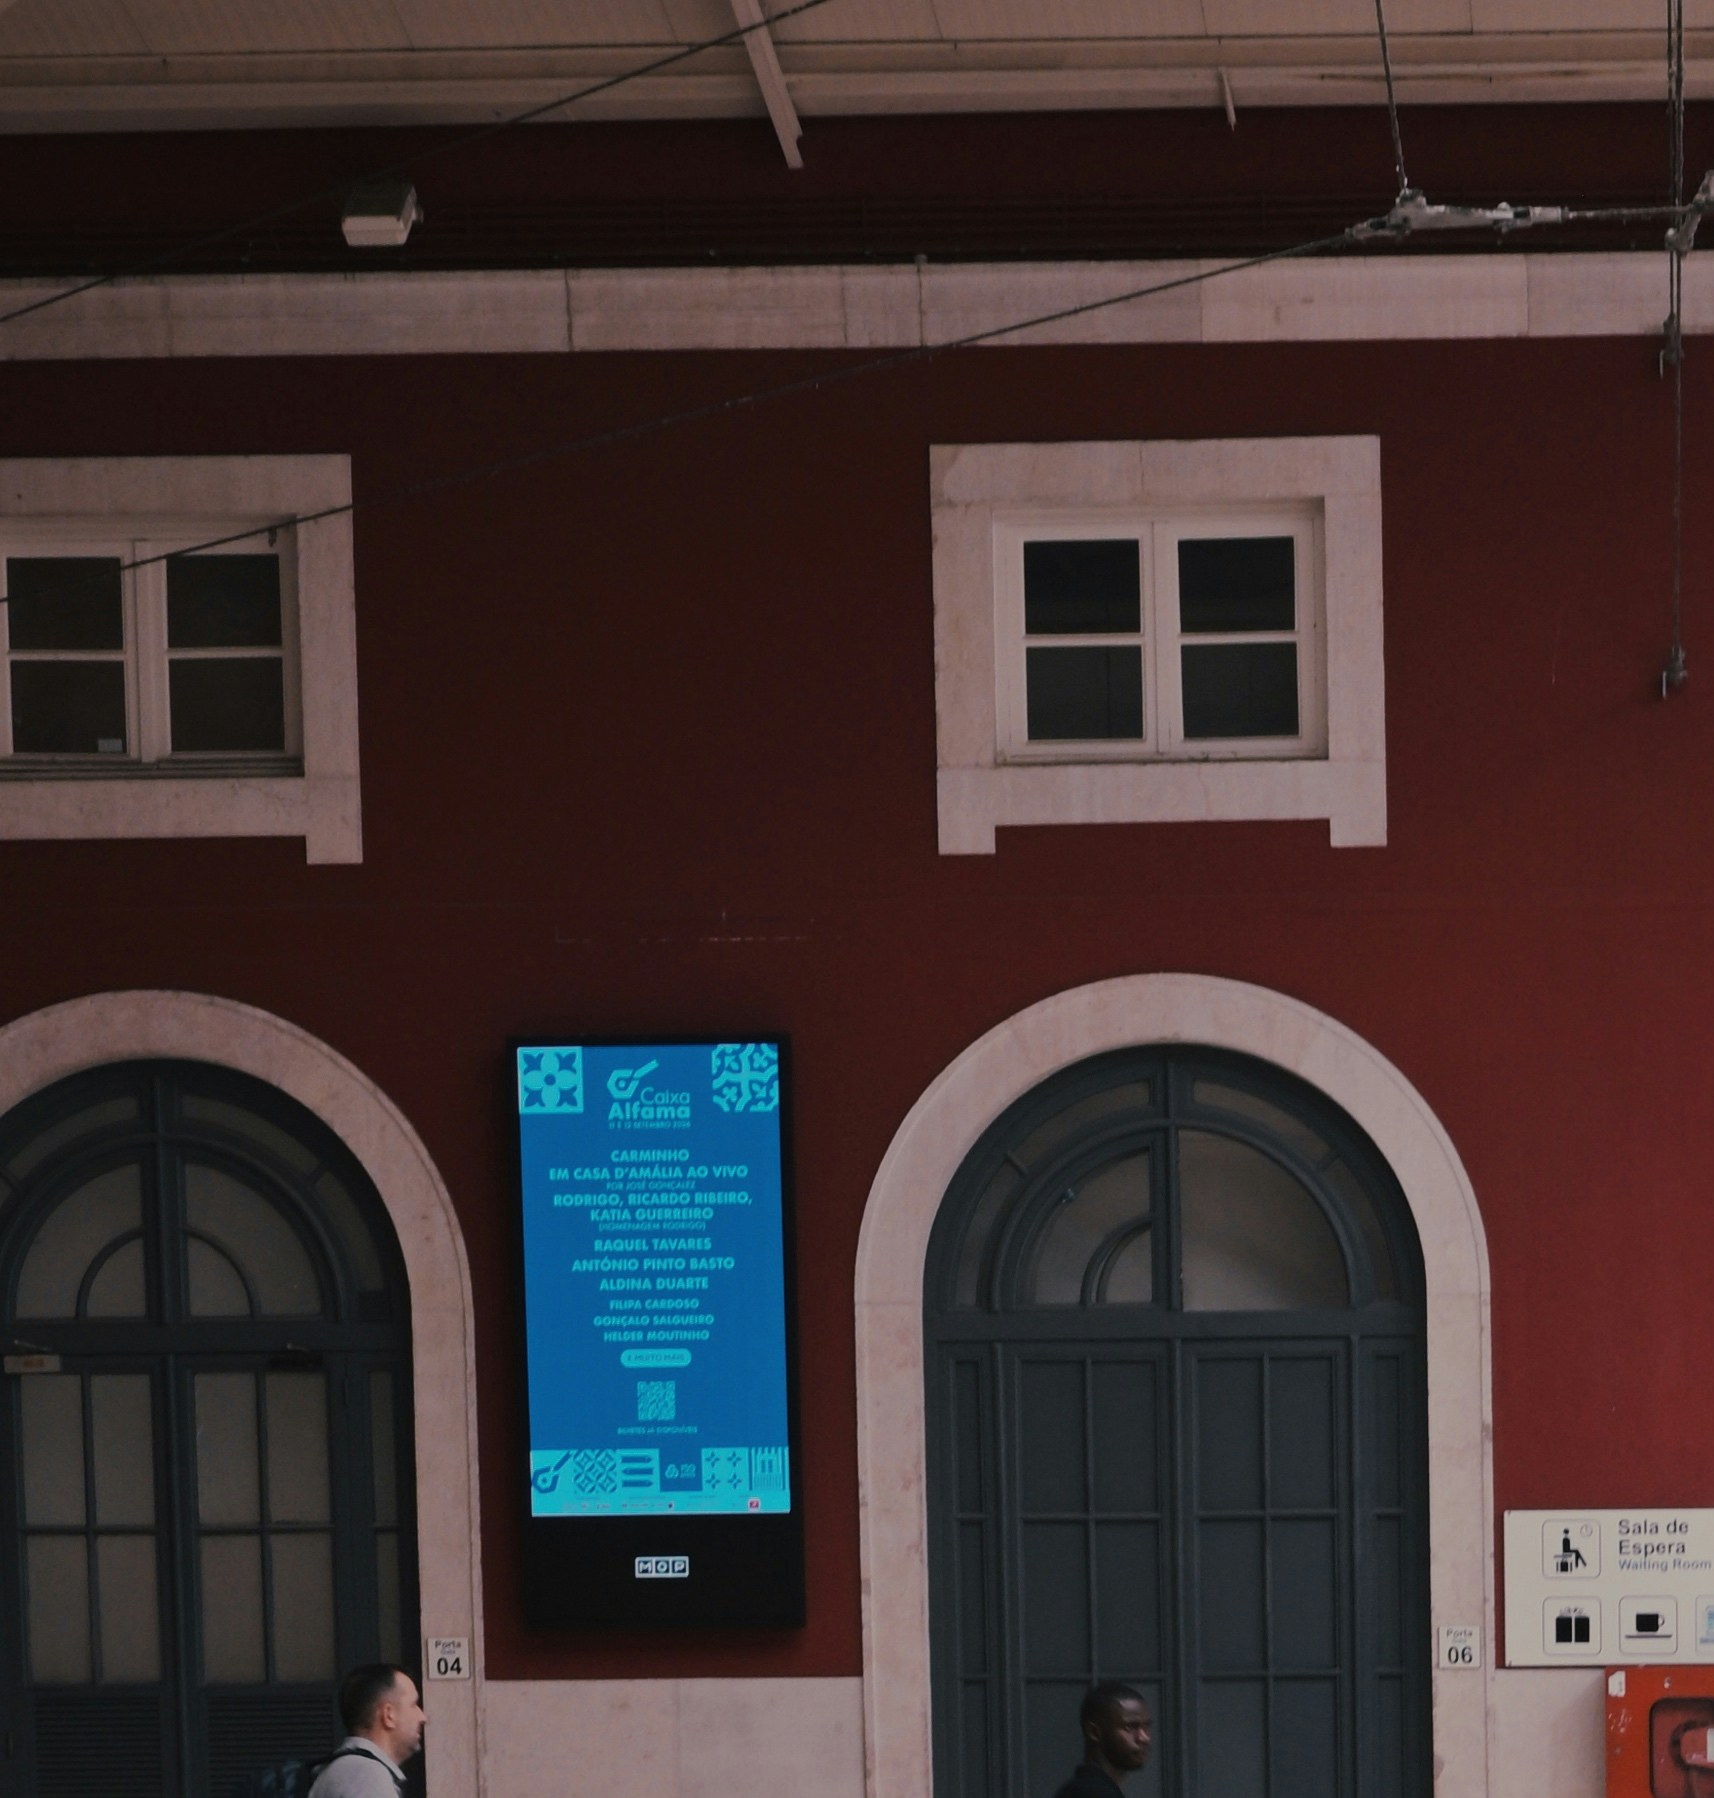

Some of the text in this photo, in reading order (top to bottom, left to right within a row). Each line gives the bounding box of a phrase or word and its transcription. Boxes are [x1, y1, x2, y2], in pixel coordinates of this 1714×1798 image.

[640, 1087, 690, 1104] Caixa
[608, 1102, 691, 1120] Alfama
[610, 1149, 690, 1163] CARMINHO
[549, 1168, 569, 1181] EM
[573, 1167, 610, 1180] CASA
[687, 1166, 708, 1178] AO
[713, 1165, 748, 1178] VIVO
[554, 1191, 752, 1207] RODRIGO, RICARDO RIBEIRO,
[635, 1207, 714, 1221] GUERREIRO
[594, 1237, 712, 1252] RAQUEL TAVARES
[572, 1256, 735, 1272] ANTÓNIO PINTO BASTO
[600, 1277, 709, 1291] ALDINA DUARTE
[610, 1298, 699, 1310] FILIPA CARDOSO
[593, 1314, 714, 1328] GONÇALO SALGUEIRO
[647, 1329, 709, 1341] MOUTINHO
[1618, 1519, 1689, 1535] Sala de
[1619, 1540, 1686, 1557] Espera
[638, 1558, 687, 1575] MOP
[1618, 1558, 1712, 1573] Waiting Room
[435, 1640, 461, 1649] Porta
[1448, 1646, 1473, 1664] 06
[437, 1657, 462, 1676] 04
